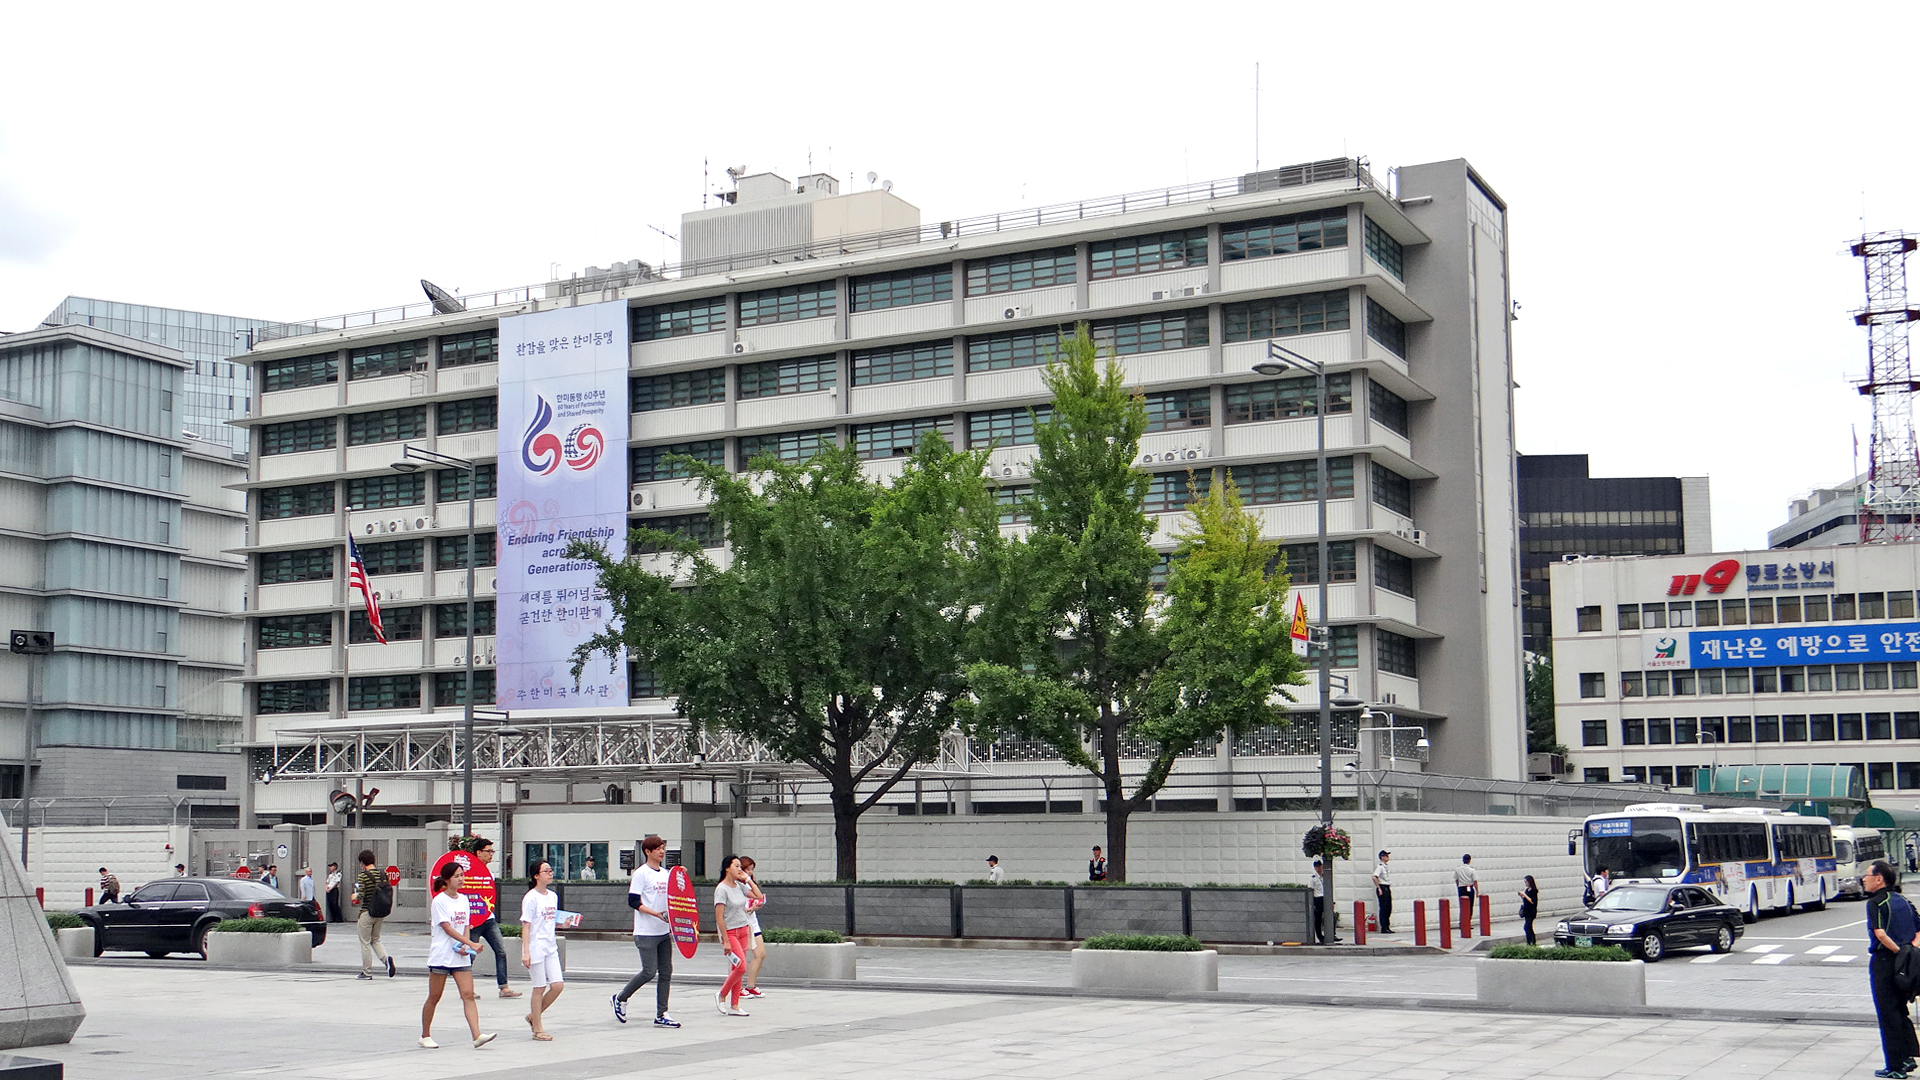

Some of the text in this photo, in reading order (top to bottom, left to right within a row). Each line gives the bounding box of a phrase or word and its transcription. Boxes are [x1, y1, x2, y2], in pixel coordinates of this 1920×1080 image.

[516, 329, 613, 357] 환갑을 맞은 한미동맹
[556, 389, 606, 403] 한미동맹 60주년
[507, 526, 615, 546] Enduring Friendship
[527, 561, 594, 575] Generations
[1666, 559, 1740, 596] 119
[1746, 560, 1834, 583] 종로소방서
[519, 589, 553, 605] 세대를
[518, 605, 602, 625] 굳건한 한미관계
[1700, 637, 1768, 660] 재난은
[1776, 634, 1870, 658] 예방으로
